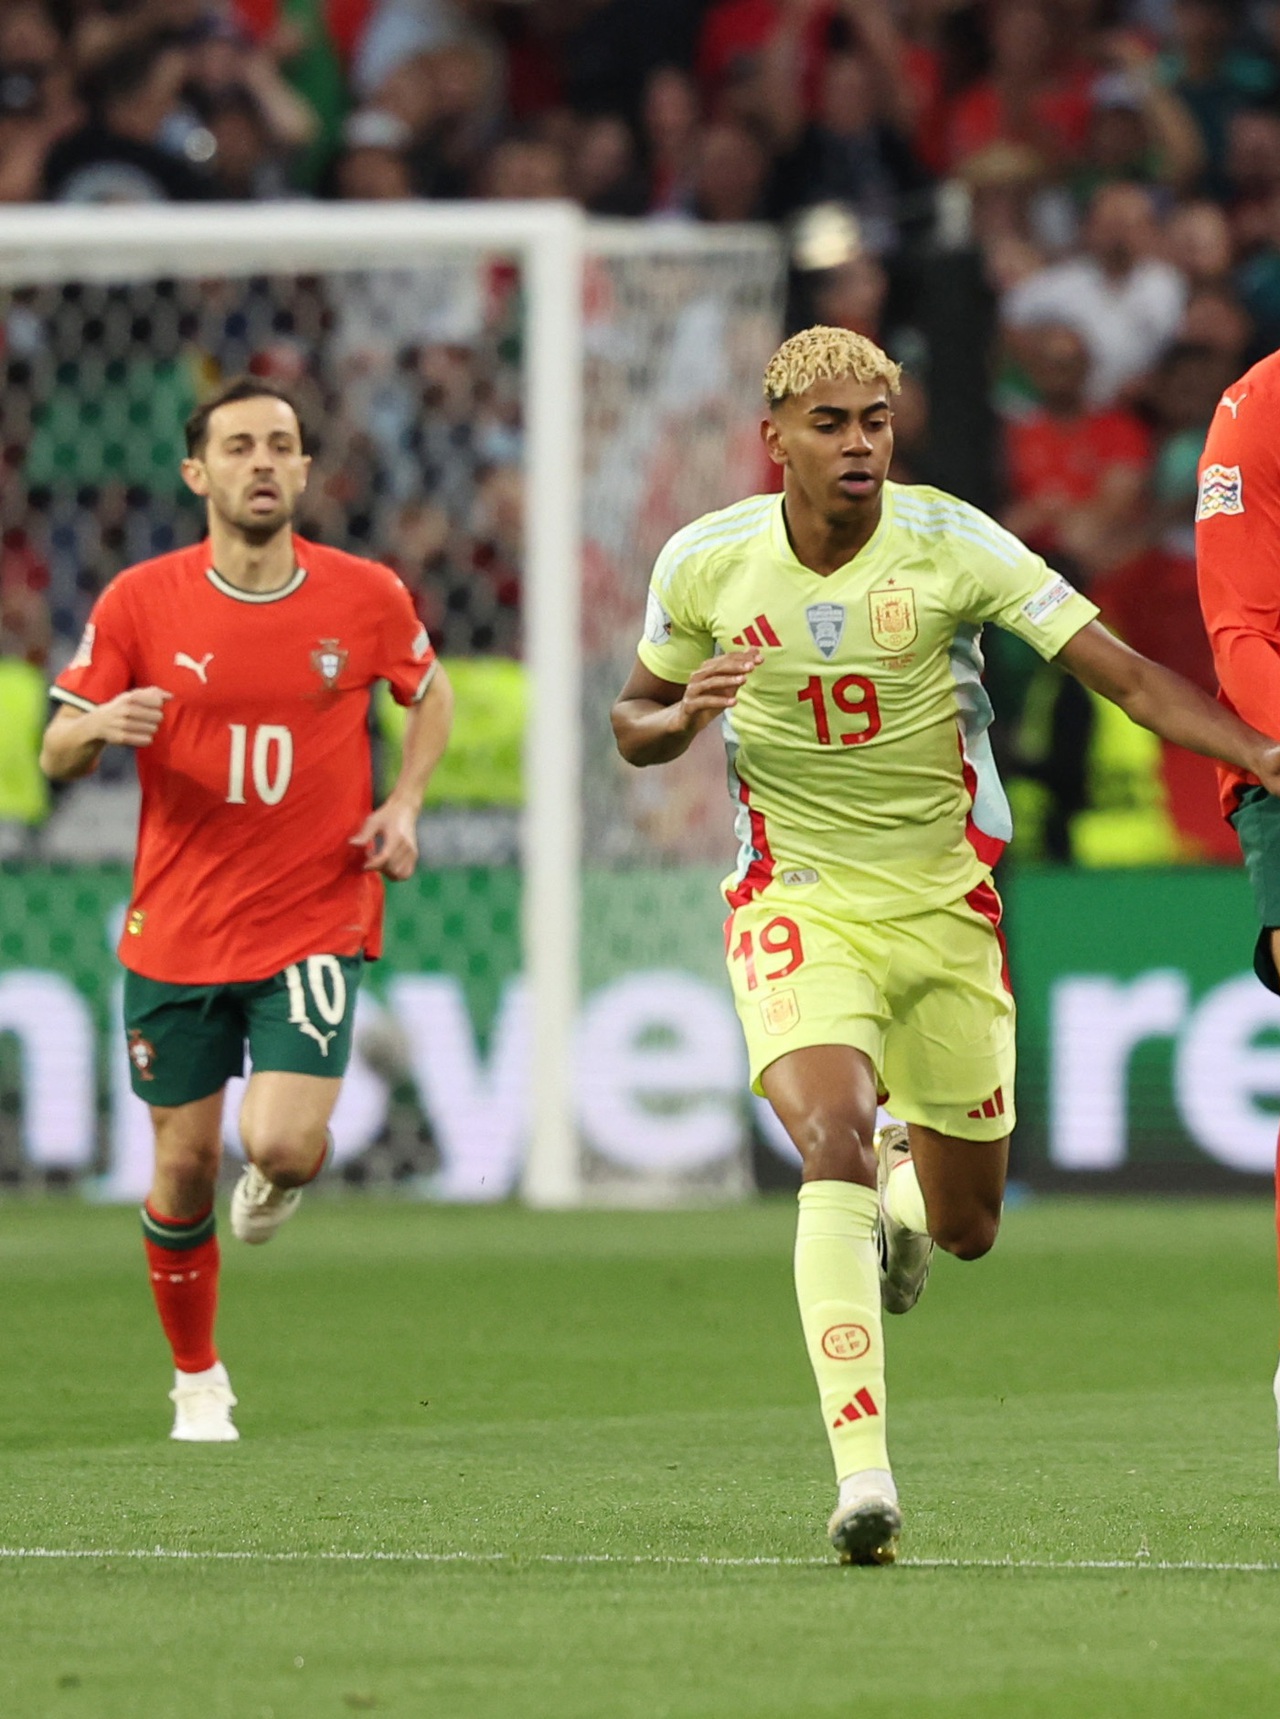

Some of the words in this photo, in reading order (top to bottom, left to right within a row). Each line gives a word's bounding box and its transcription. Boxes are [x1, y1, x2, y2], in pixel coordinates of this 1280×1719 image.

[797, 673, 882, 746] 19
[225, 723, 294, 806] 10
[283, 953, 347, 1026] 10
[732, 915, 804, 992] 19
